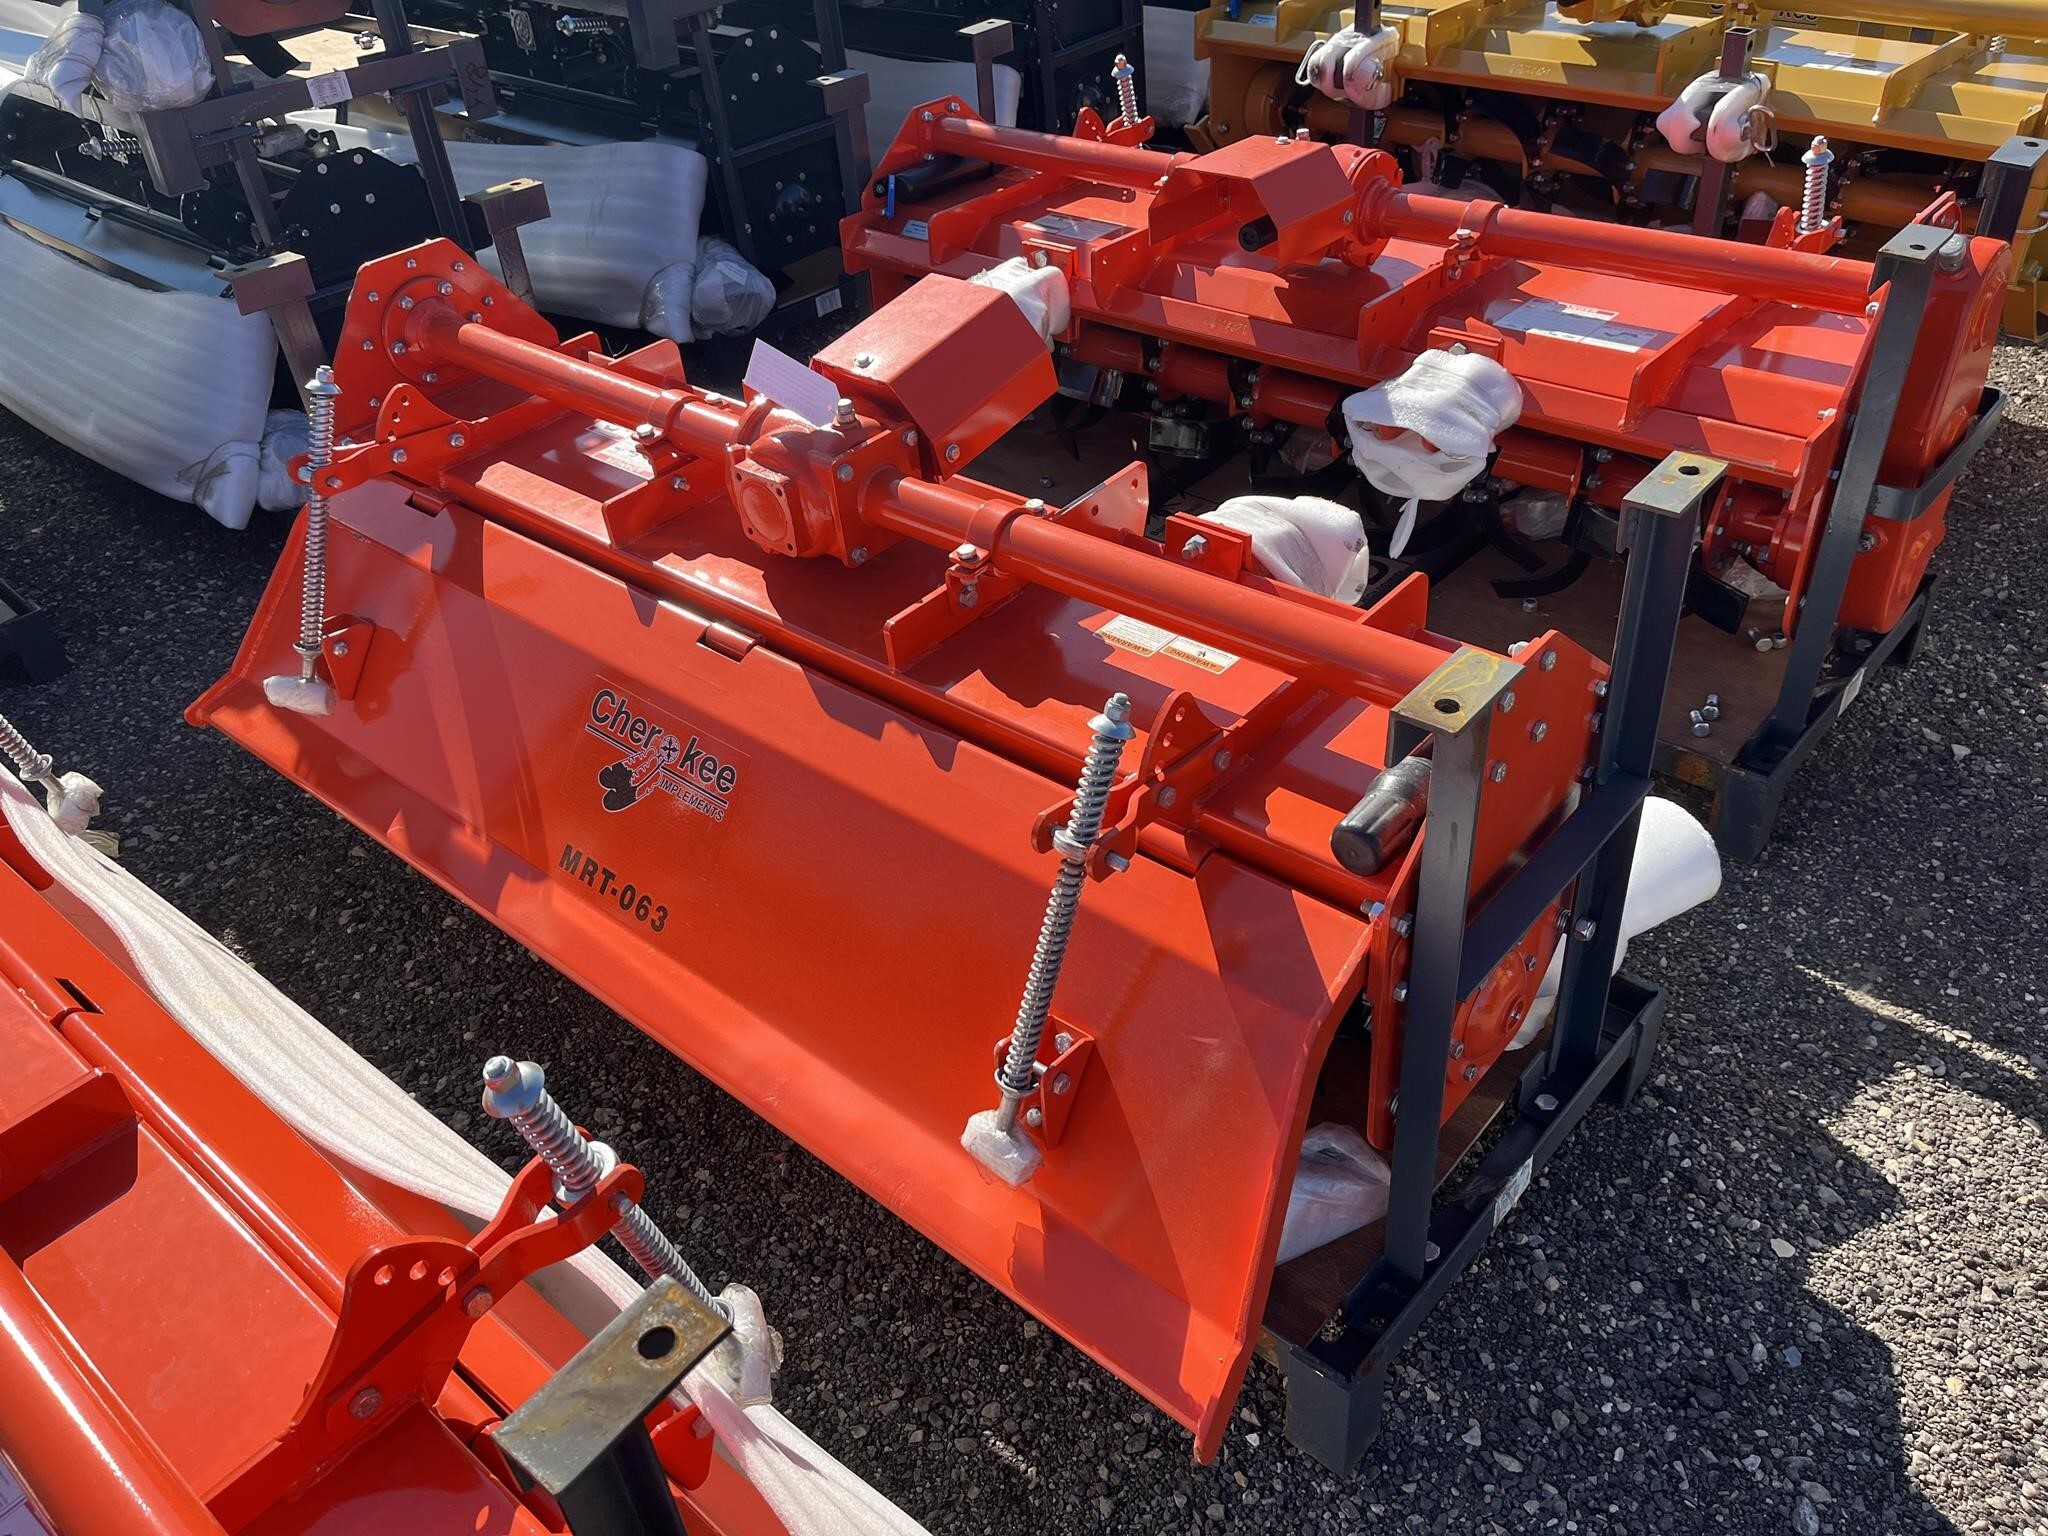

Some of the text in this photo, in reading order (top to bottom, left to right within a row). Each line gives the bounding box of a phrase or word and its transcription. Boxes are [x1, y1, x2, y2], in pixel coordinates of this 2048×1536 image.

[1101, 632, 1143, 652] WARNING
[1171, 649, 1212, 668] WARNING
[591, 688, 736, 795] Cherokee
[659, 777, 726, 822] IMPLEMENTS
[559, 845, 669, 932] MRT-063
